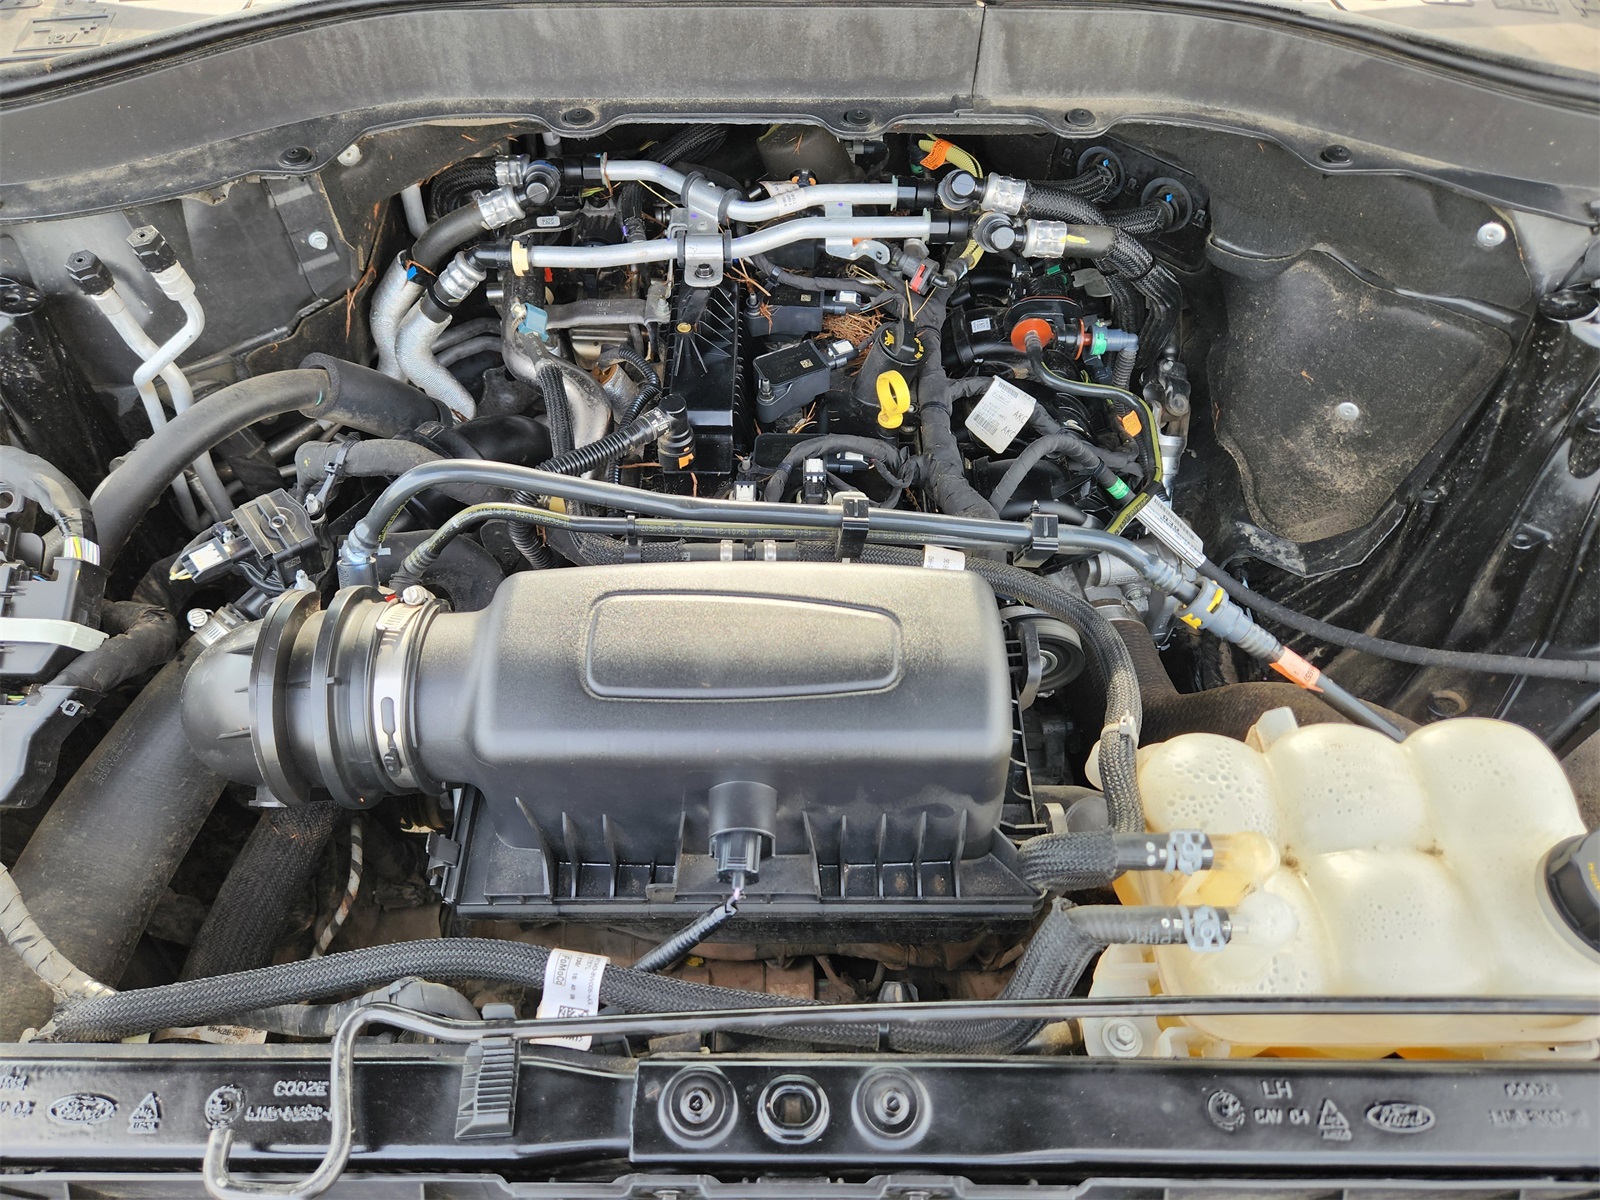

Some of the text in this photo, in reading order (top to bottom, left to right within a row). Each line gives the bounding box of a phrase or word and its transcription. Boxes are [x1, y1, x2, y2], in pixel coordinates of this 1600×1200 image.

[1012, 410, 1028, 424] AKC
[1000, 425, 1017, 439] AKC
[556, 955, 570, 986] FoMoCo
[1261, 1080, 1293, 1100] LH
[1373, 1102, 1430, 1131] Ford
